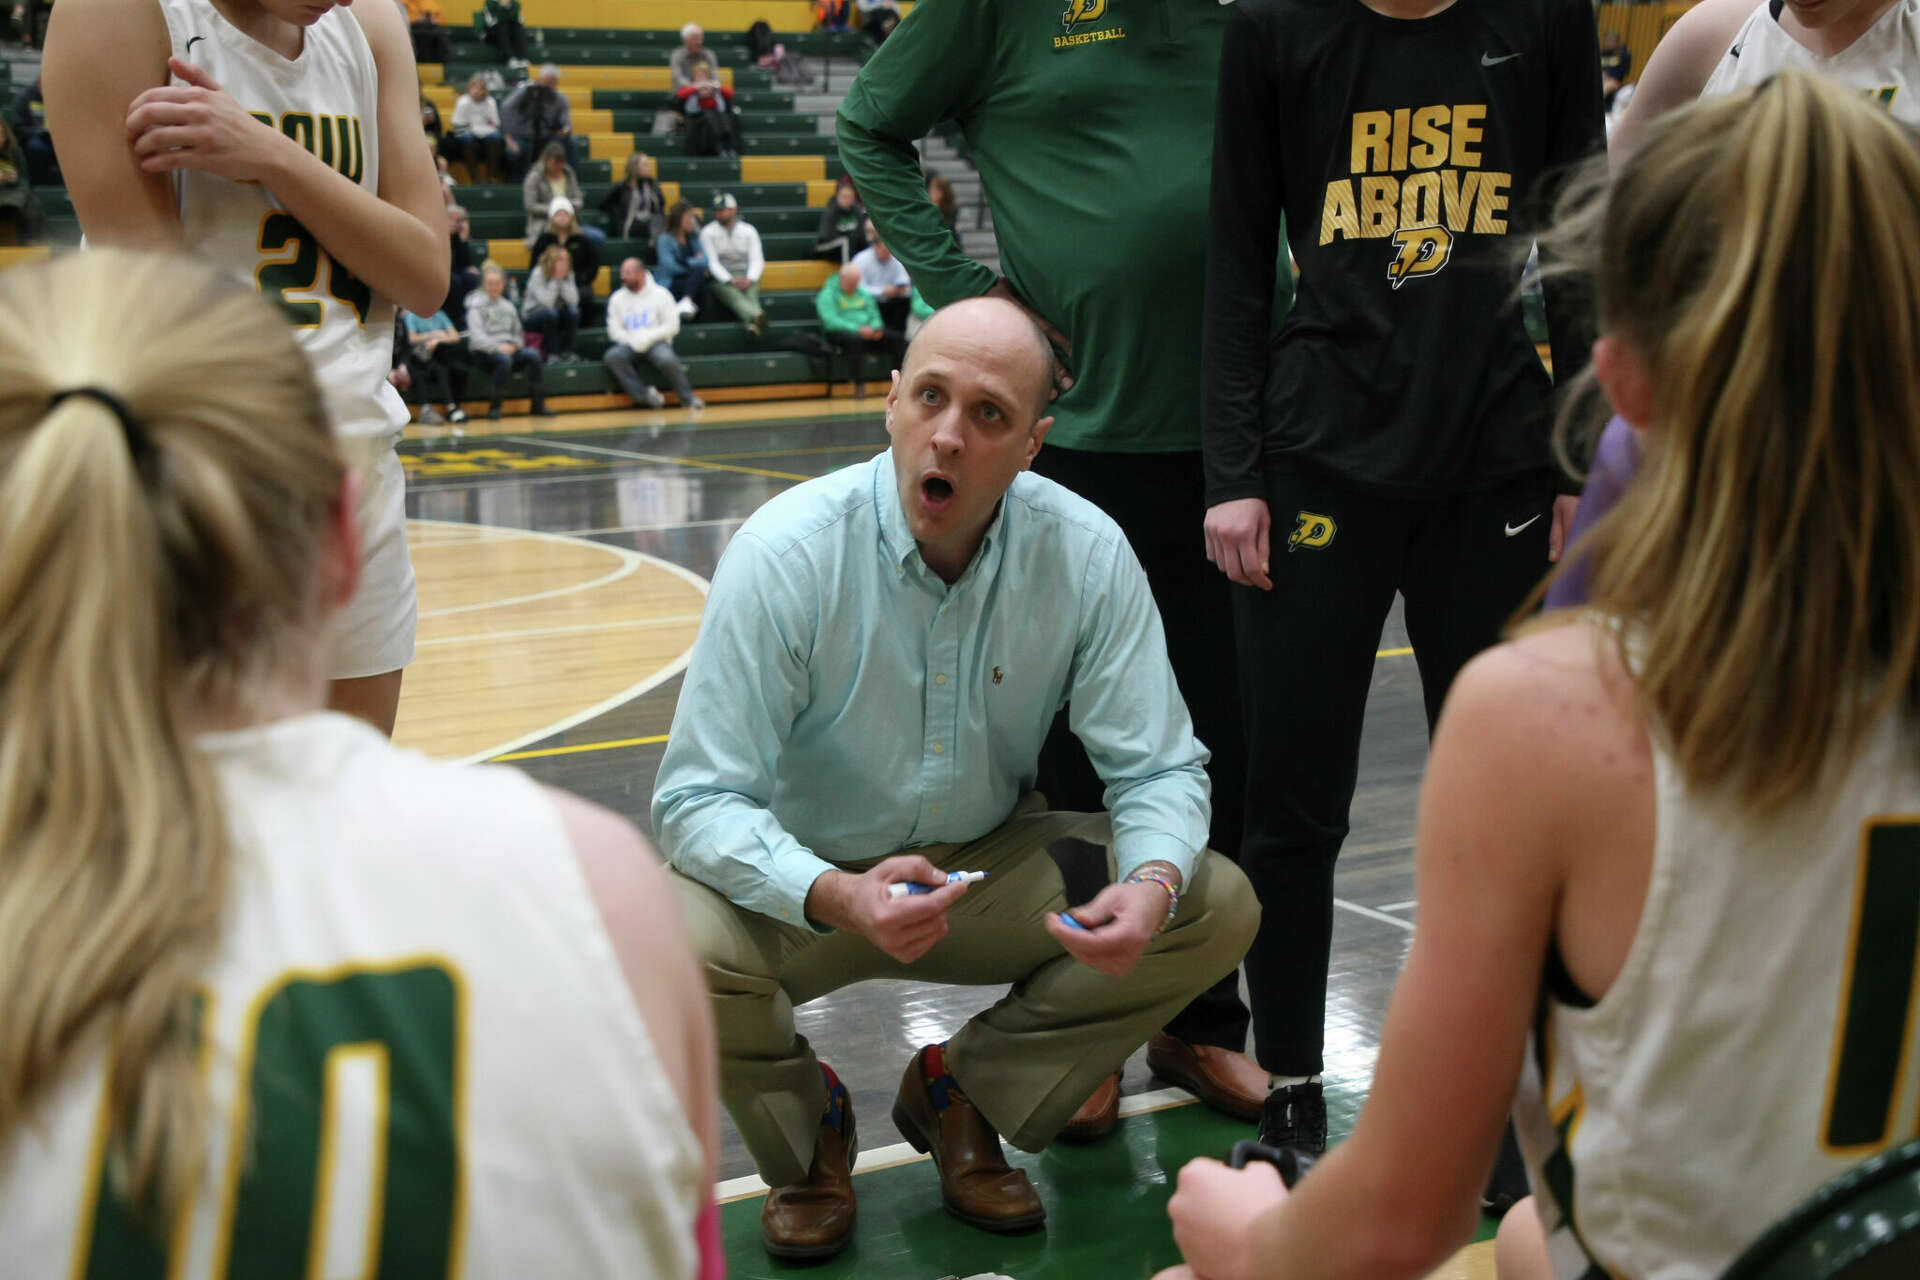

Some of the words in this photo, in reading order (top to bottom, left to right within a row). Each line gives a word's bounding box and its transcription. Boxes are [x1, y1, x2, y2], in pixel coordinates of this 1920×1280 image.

[1053, 28, 1126, 48] BASKETBALL
[1350, 104, 1487, 174] RISE
[1319, 169, 1512, 247] ABOVE
